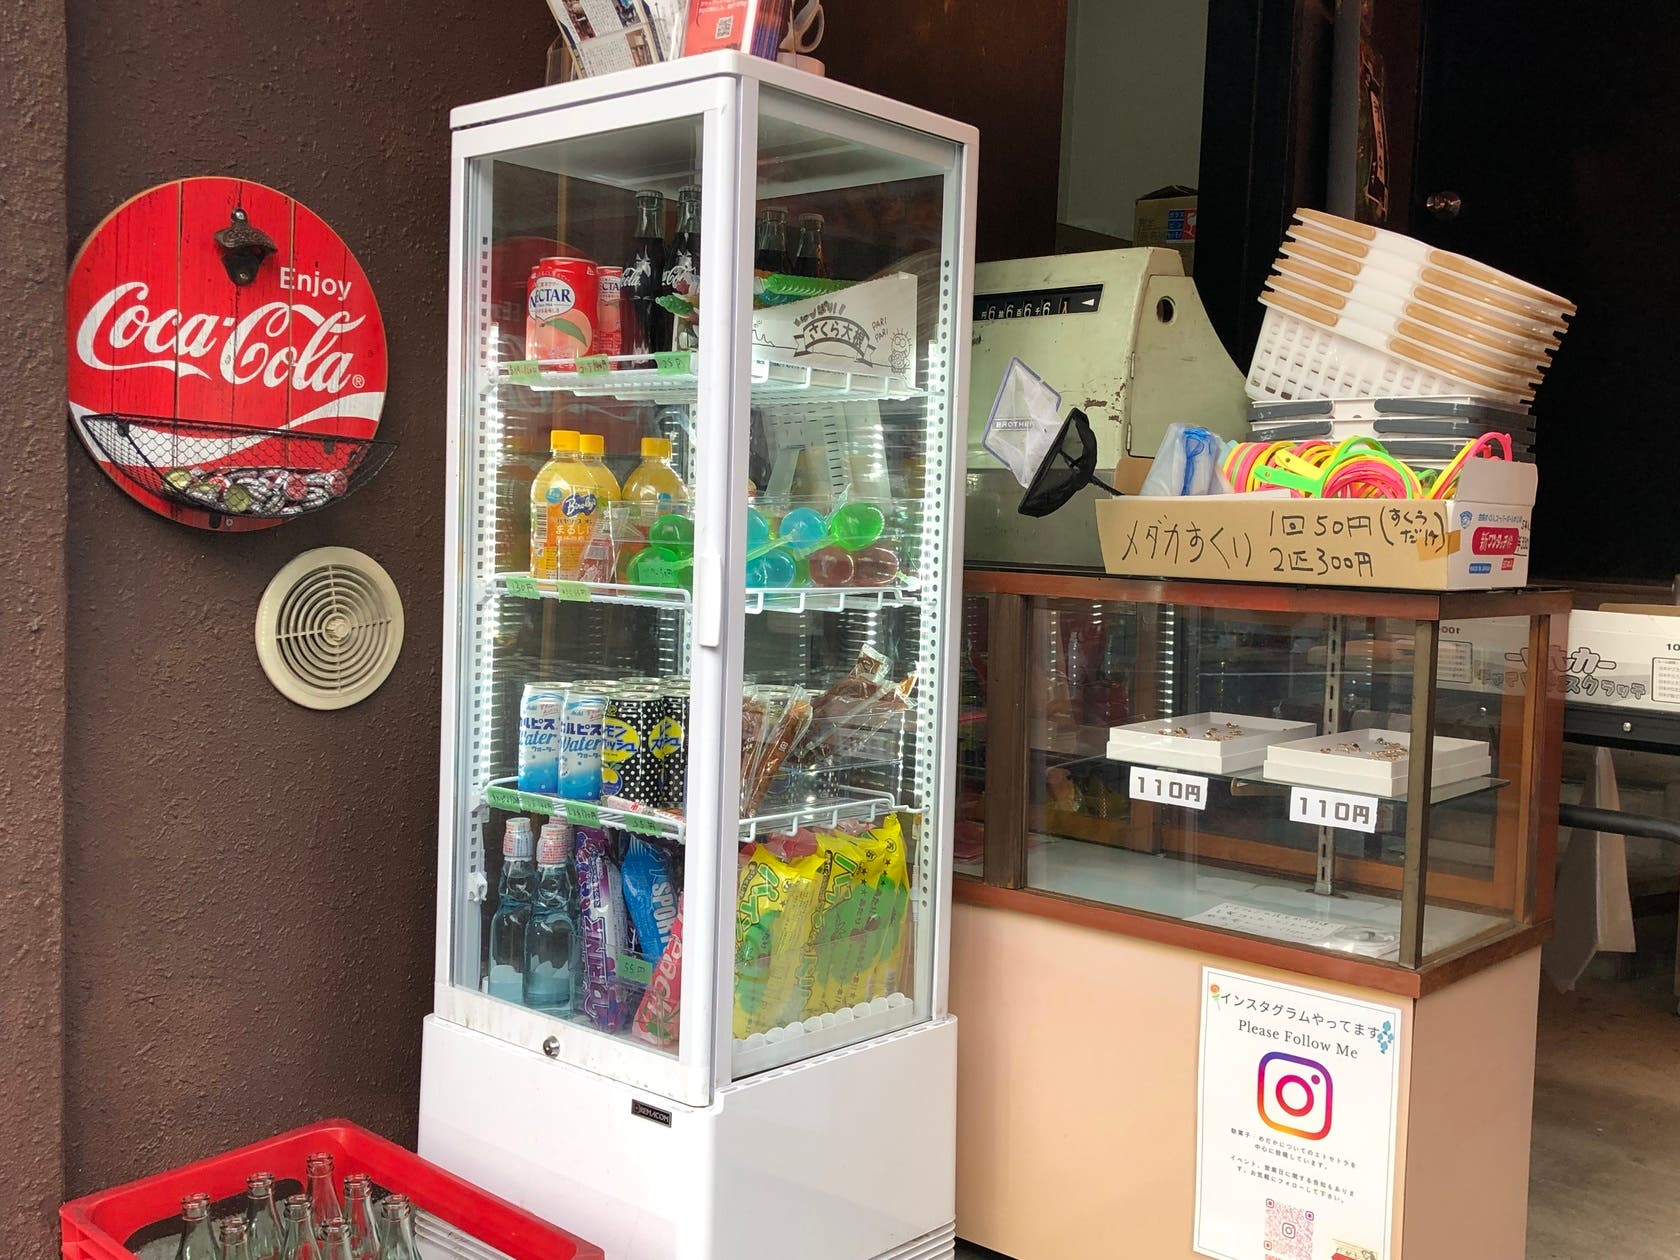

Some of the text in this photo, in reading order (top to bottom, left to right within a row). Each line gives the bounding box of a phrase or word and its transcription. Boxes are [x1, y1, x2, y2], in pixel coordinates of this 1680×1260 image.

[280, 266, 352, 300] Enjoy
[530, 288, 571, 308] NECTAR
[77, 281, 366, 394] Coca-Cola
[809, 320, 866, 350] さくら大根
[1136, 776, 1201, 802] 110円
[1299, 796, 1371, 825] 110円
[1220, 991, 1381, 1039] インスタグラムやってます
[1238, 1019, 1359, 1059] Please Follow Me
